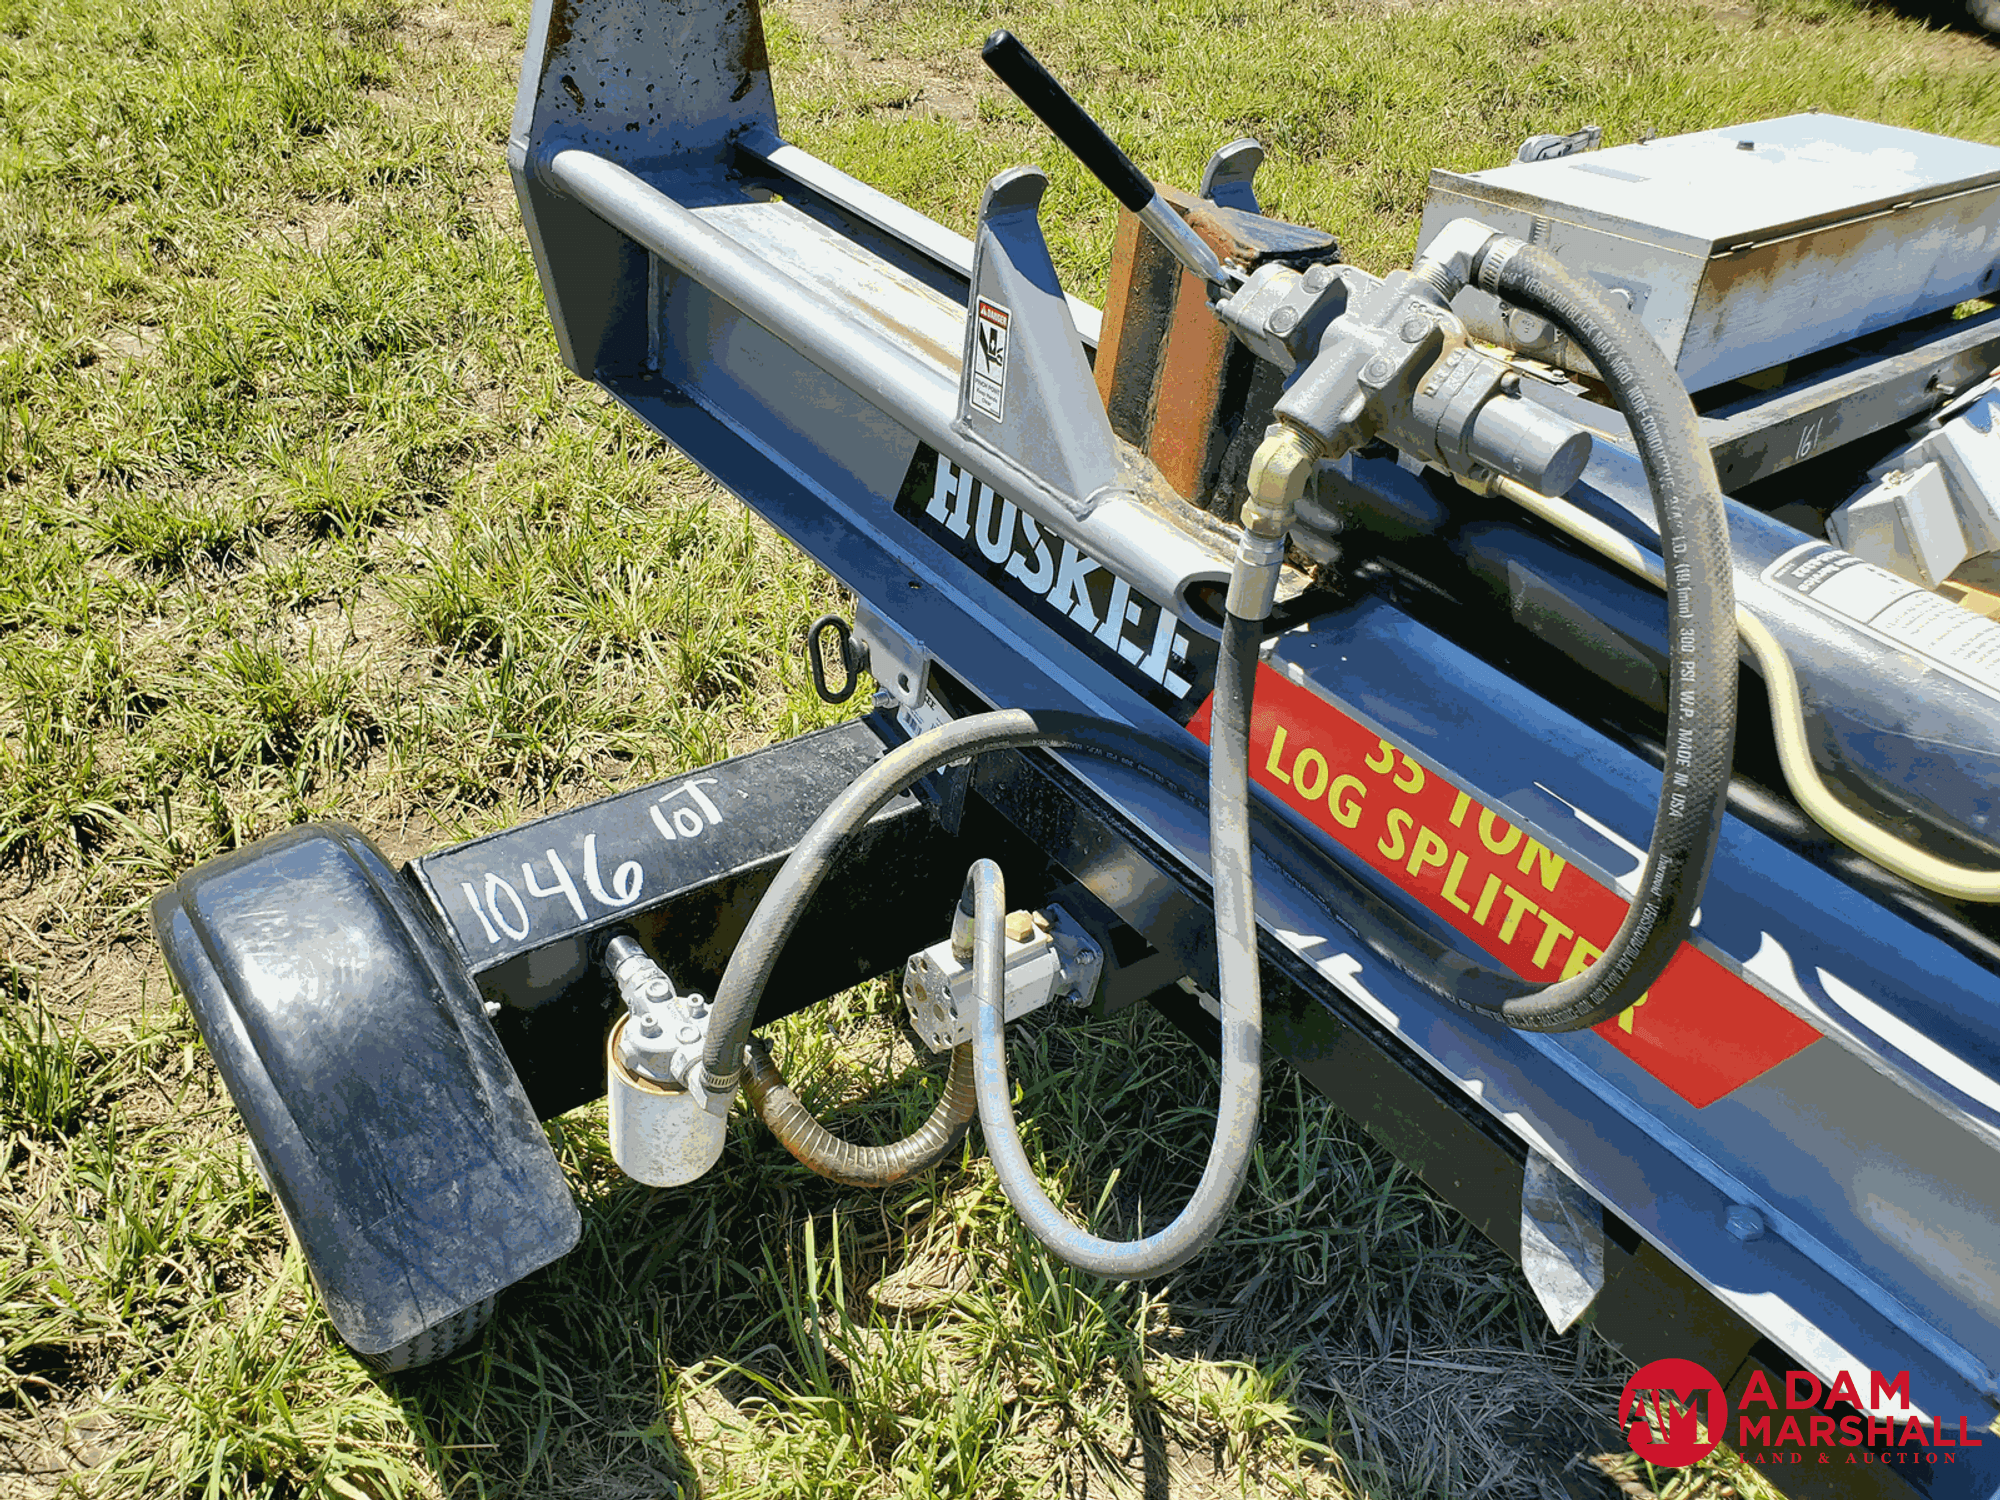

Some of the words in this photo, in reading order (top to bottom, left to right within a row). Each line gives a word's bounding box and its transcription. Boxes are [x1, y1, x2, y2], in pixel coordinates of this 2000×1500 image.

[1591, 330, 1618, 360] MAX
[1680, 627, 1695, 653] 300
[1681, 661, 1695, 682] PSI
[1679, 689, 1694, 720] W.P.
[1676, 728, 1693, 767] MADE
[1266, 725, 1367, 829] LOG
[1672, 771, 1688, 787] IN
[1667, 791, 1685, 818] USA
[461, 833, 644, 943] 1046
